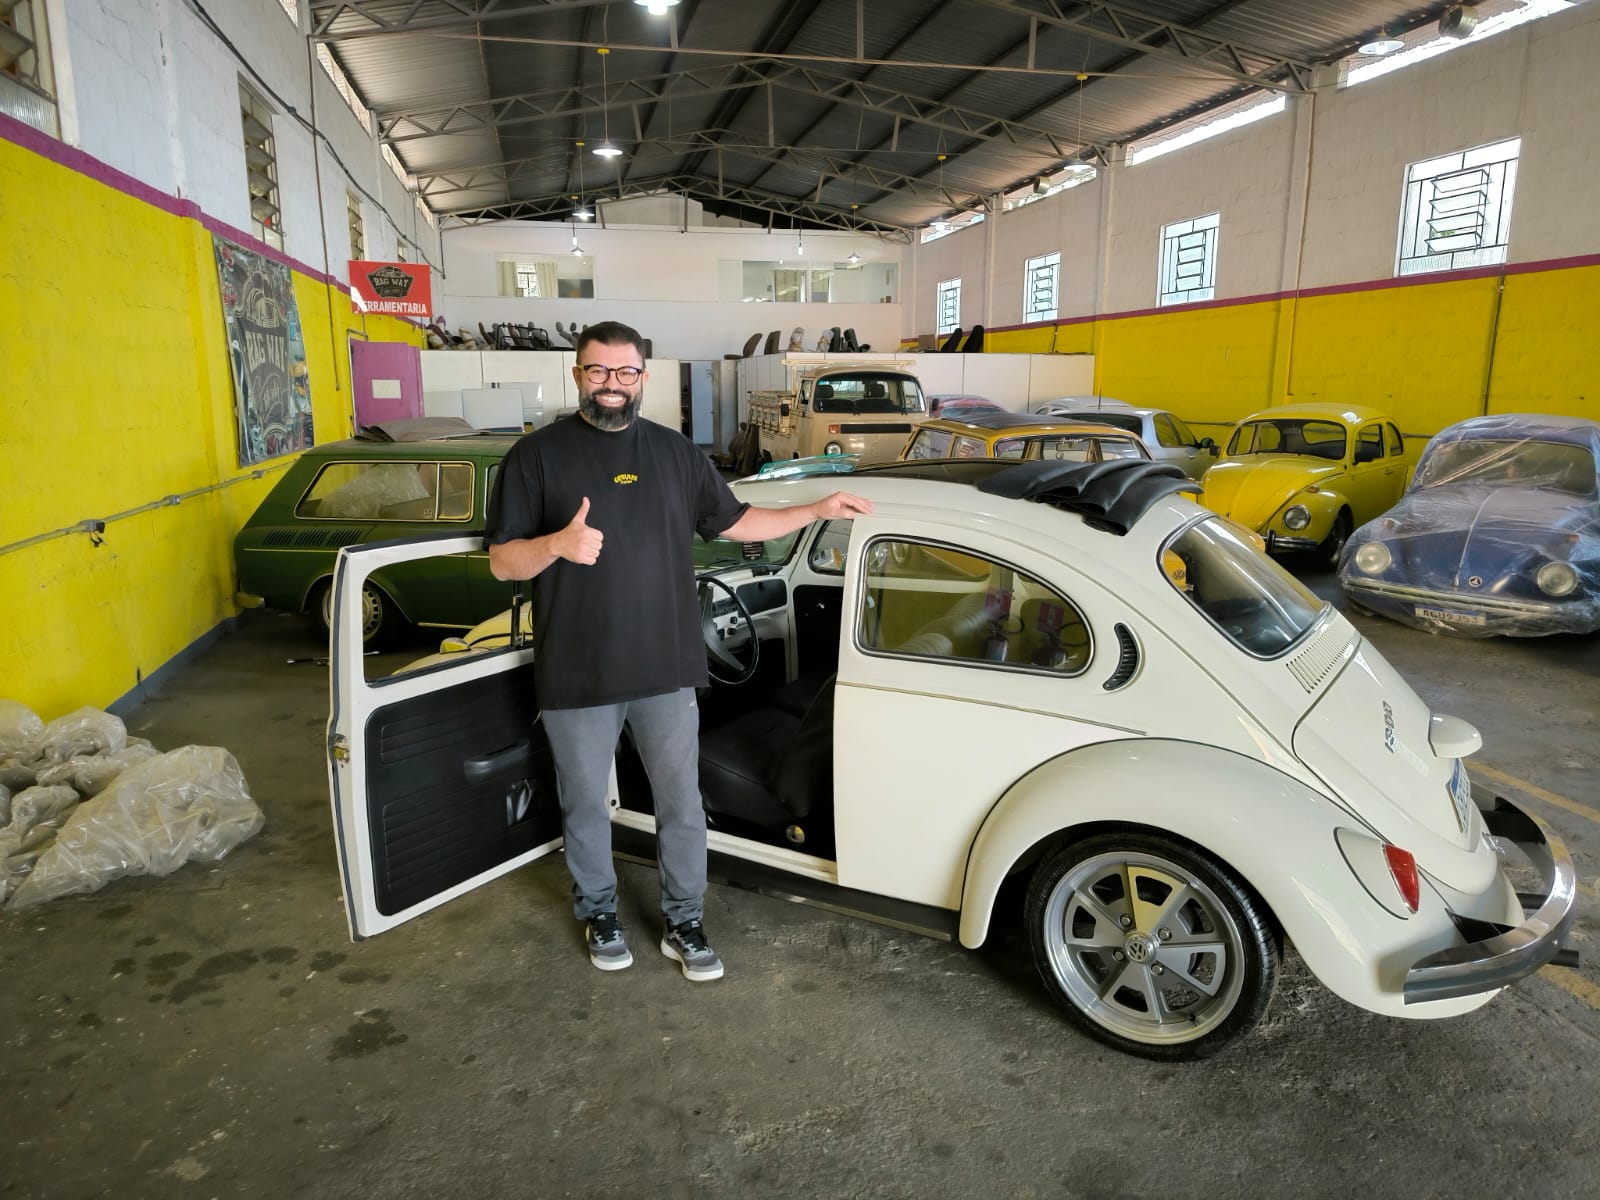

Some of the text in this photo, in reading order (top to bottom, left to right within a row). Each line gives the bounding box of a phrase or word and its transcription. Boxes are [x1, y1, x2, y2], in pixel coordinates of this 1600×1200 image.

[374, 277, 408, 287] RAG WAY
[246, 330, 285, 373] RAG WAY
